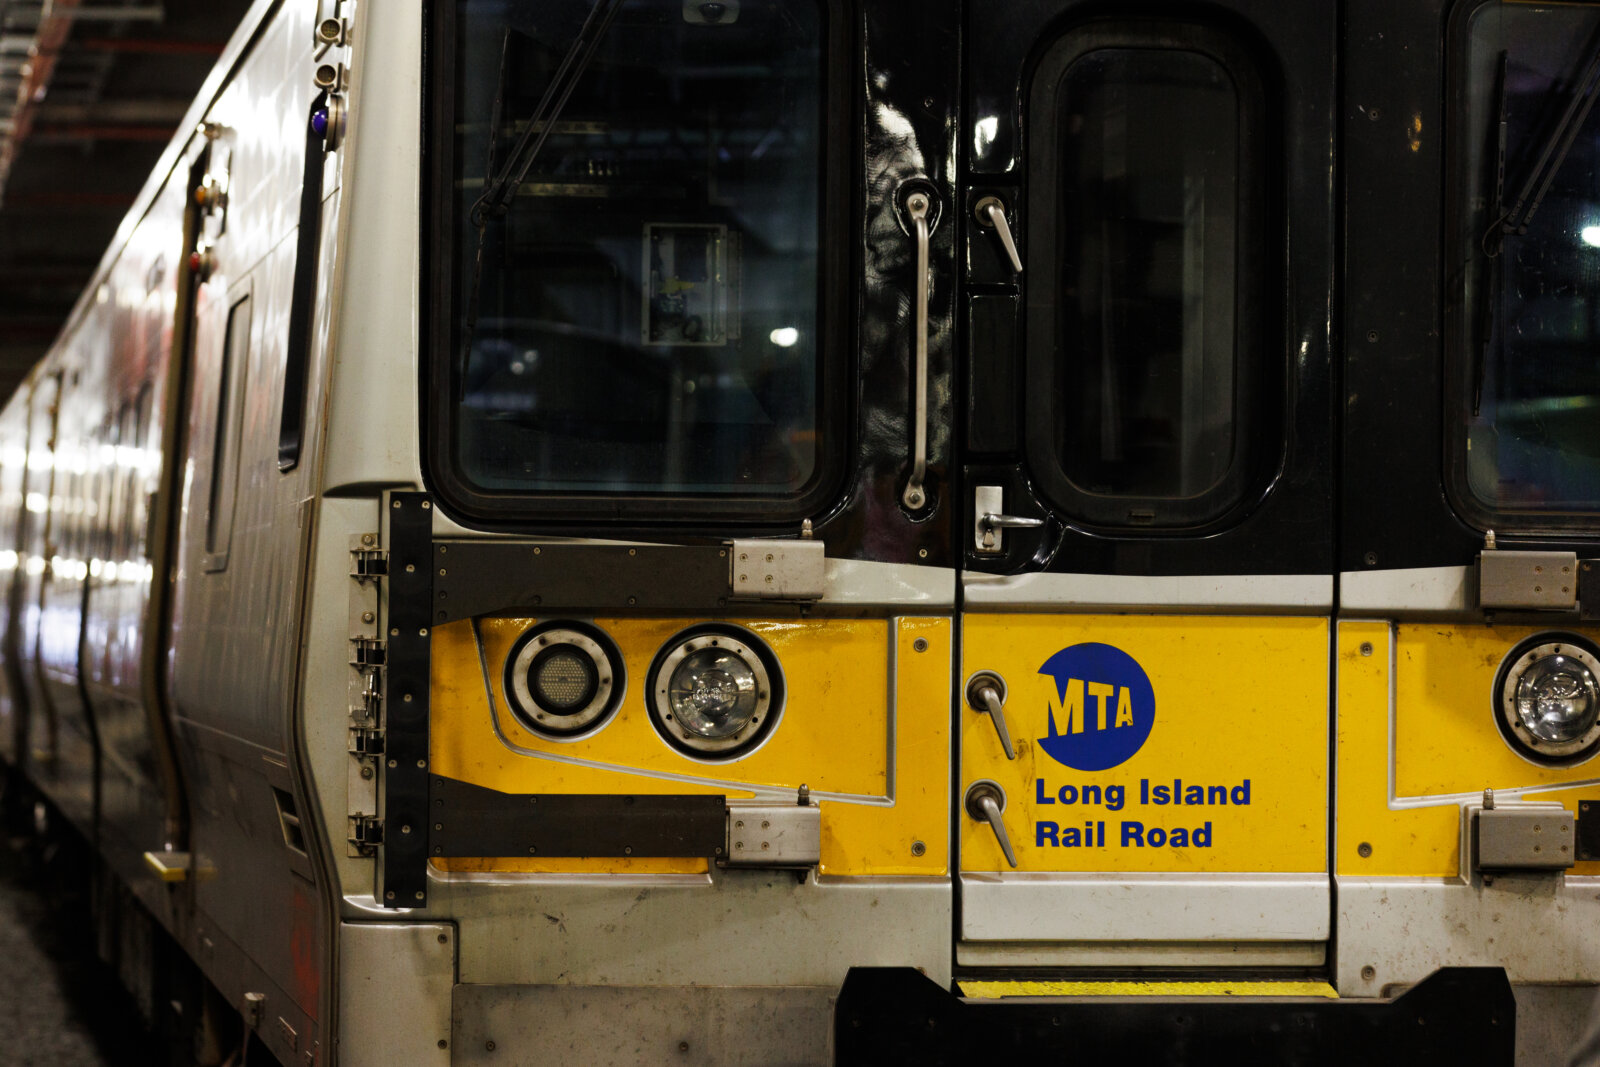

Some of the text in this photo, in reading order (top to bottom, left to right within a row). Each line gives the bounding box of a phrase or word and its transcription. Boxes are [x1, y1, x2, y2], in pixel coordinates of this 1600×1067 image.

[1038, 672, 1134, 738] MTA
[1037, 779, 1250, 810] Long Island
[1037, 822, 1211, 847] Rail Road
